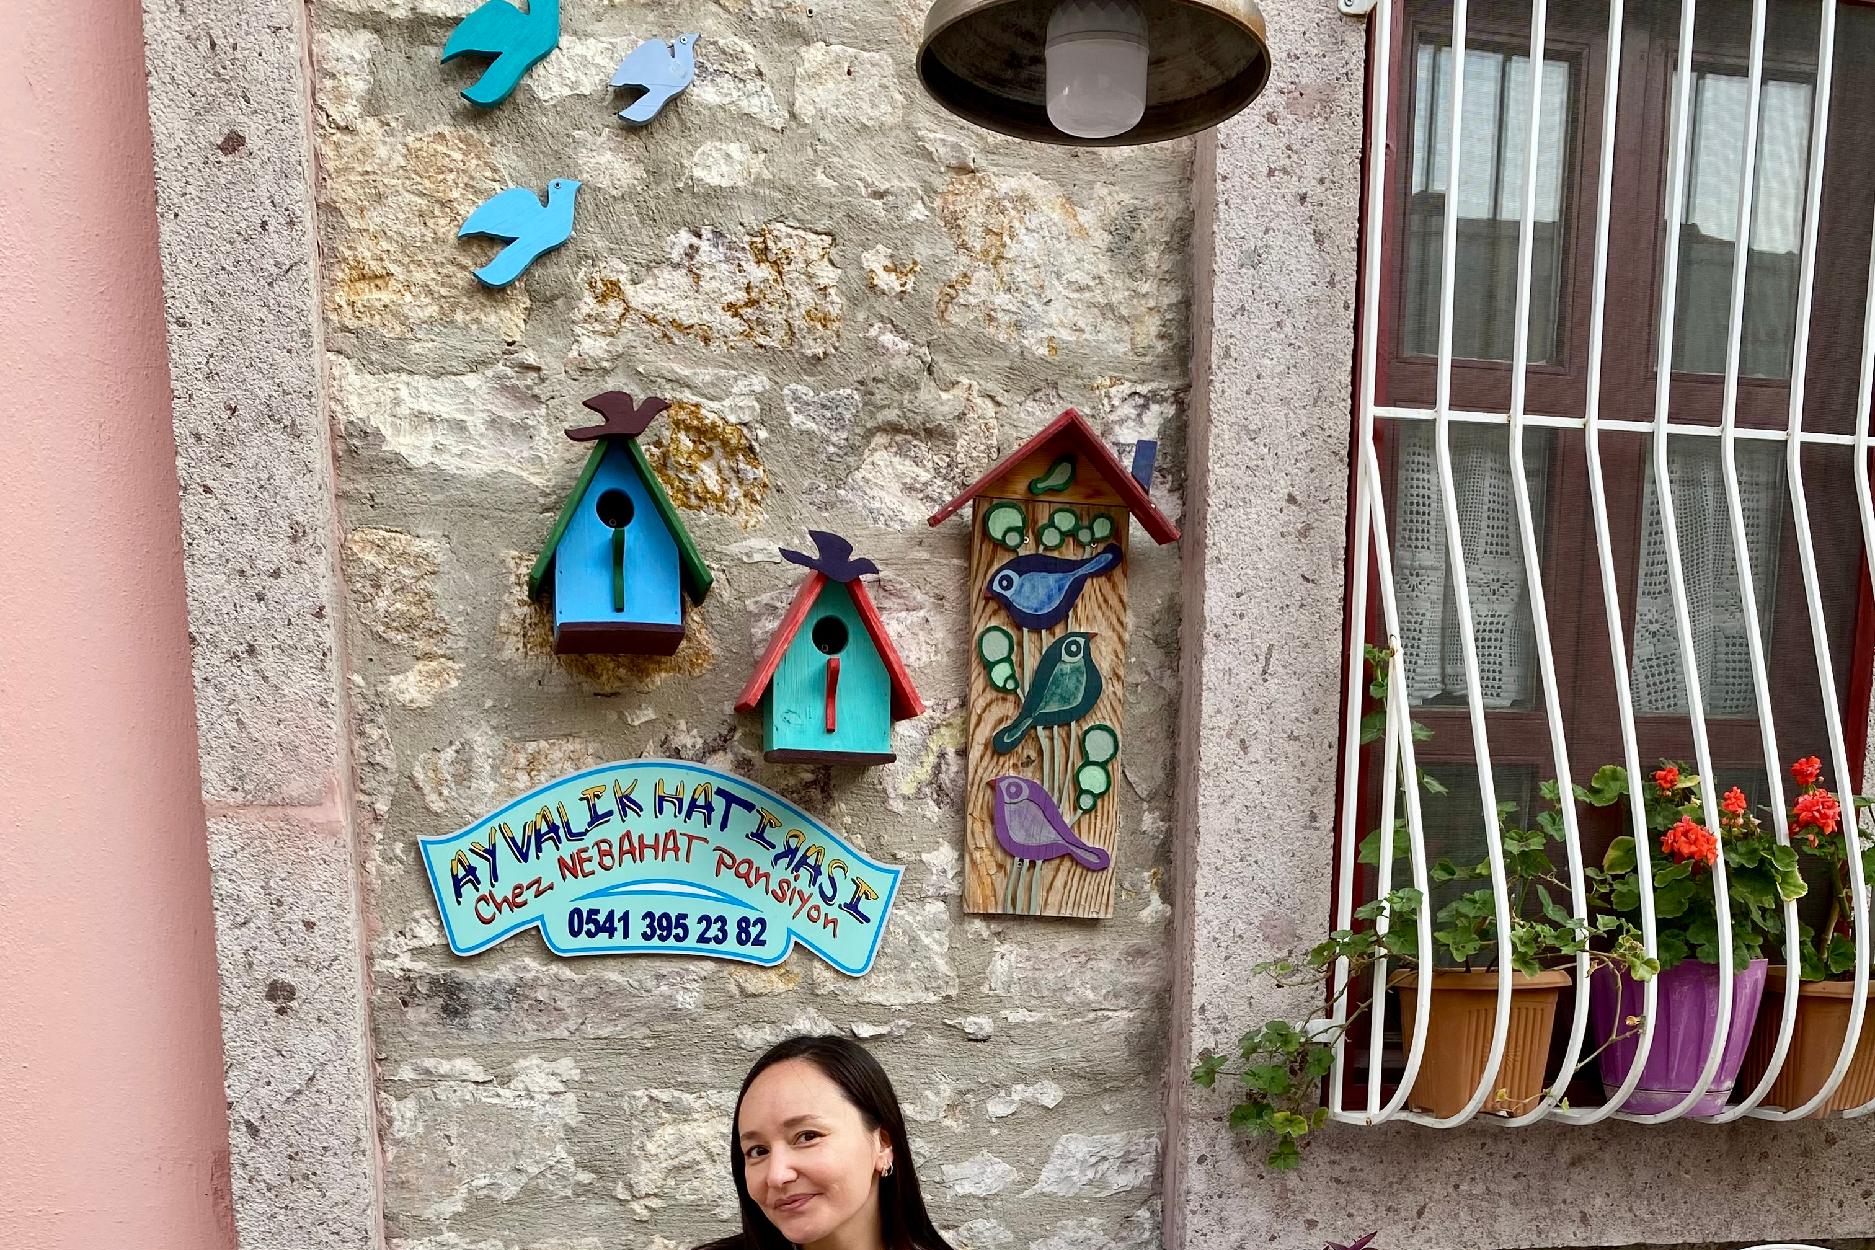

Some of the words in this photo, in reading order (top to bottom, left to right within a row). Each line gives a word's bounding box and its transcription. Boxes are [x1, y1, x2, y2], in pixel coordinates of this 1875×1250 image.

[450, 779, 643, 906] AYVALIK
[474, 876, 555, 925] Chez
[557, 831, 708, 881] NEBAHAT
[568, 907, 630, 940] 0541
[641, 911, 689, 944] 395
[696, 913, 729, 945] 23
[736, 917, 767, 947] 82
